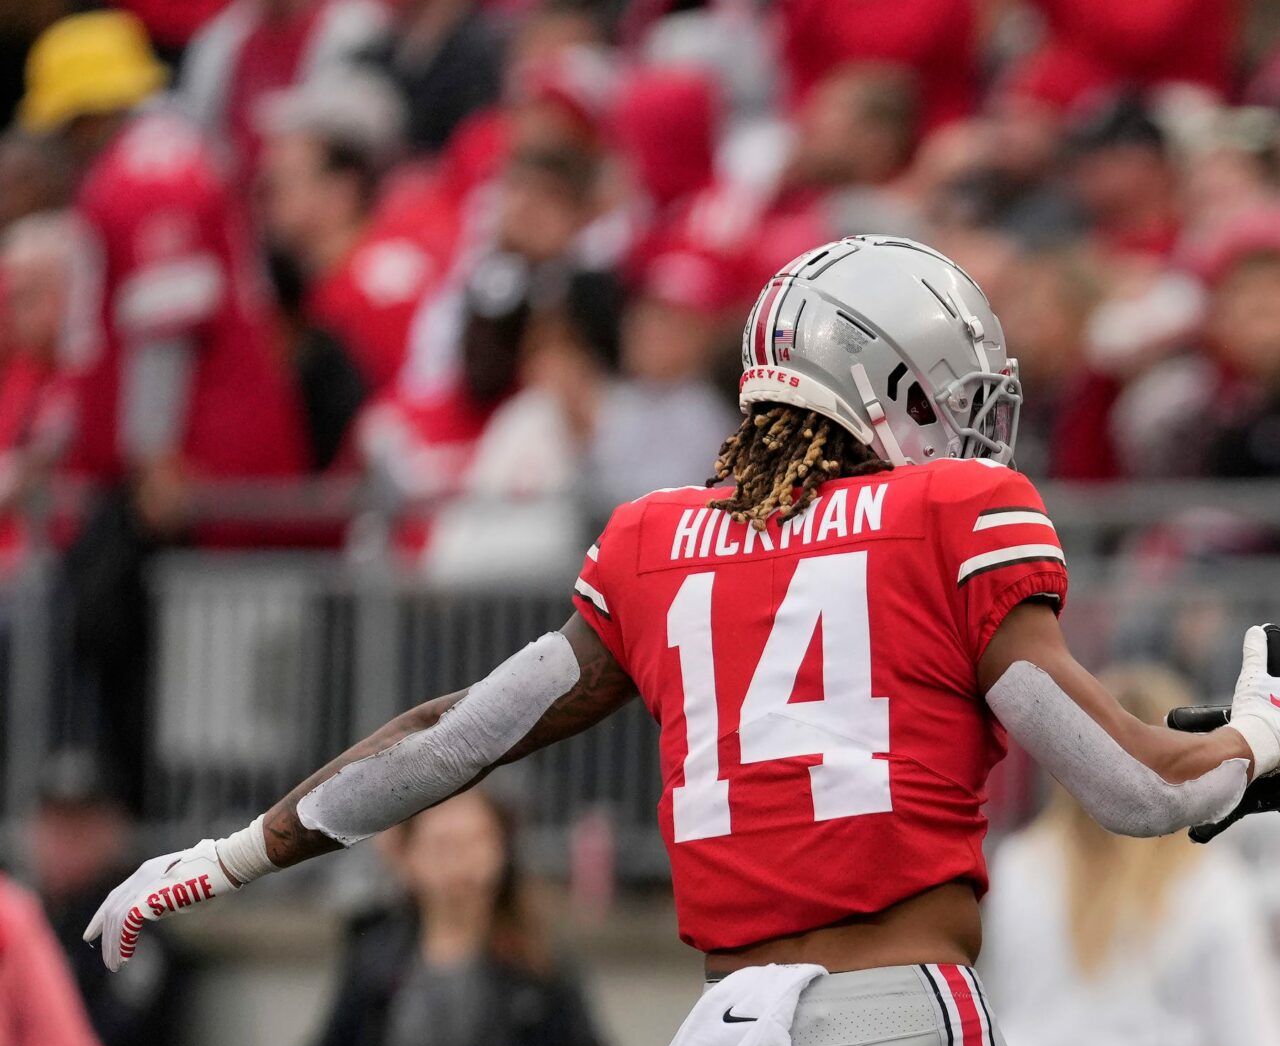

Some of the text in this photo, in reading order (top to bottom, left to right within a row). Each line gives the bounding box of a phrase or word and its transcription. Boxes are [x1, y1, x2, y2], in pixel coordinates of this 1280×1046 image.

[779, 348, 791, 361] 14
[740, 368, 800, 393] CKEYES
[669, 483, 889, 561] HICKMAN
[666, 550, 894, 844] 14
[147, 874, 216, 917] STATE
